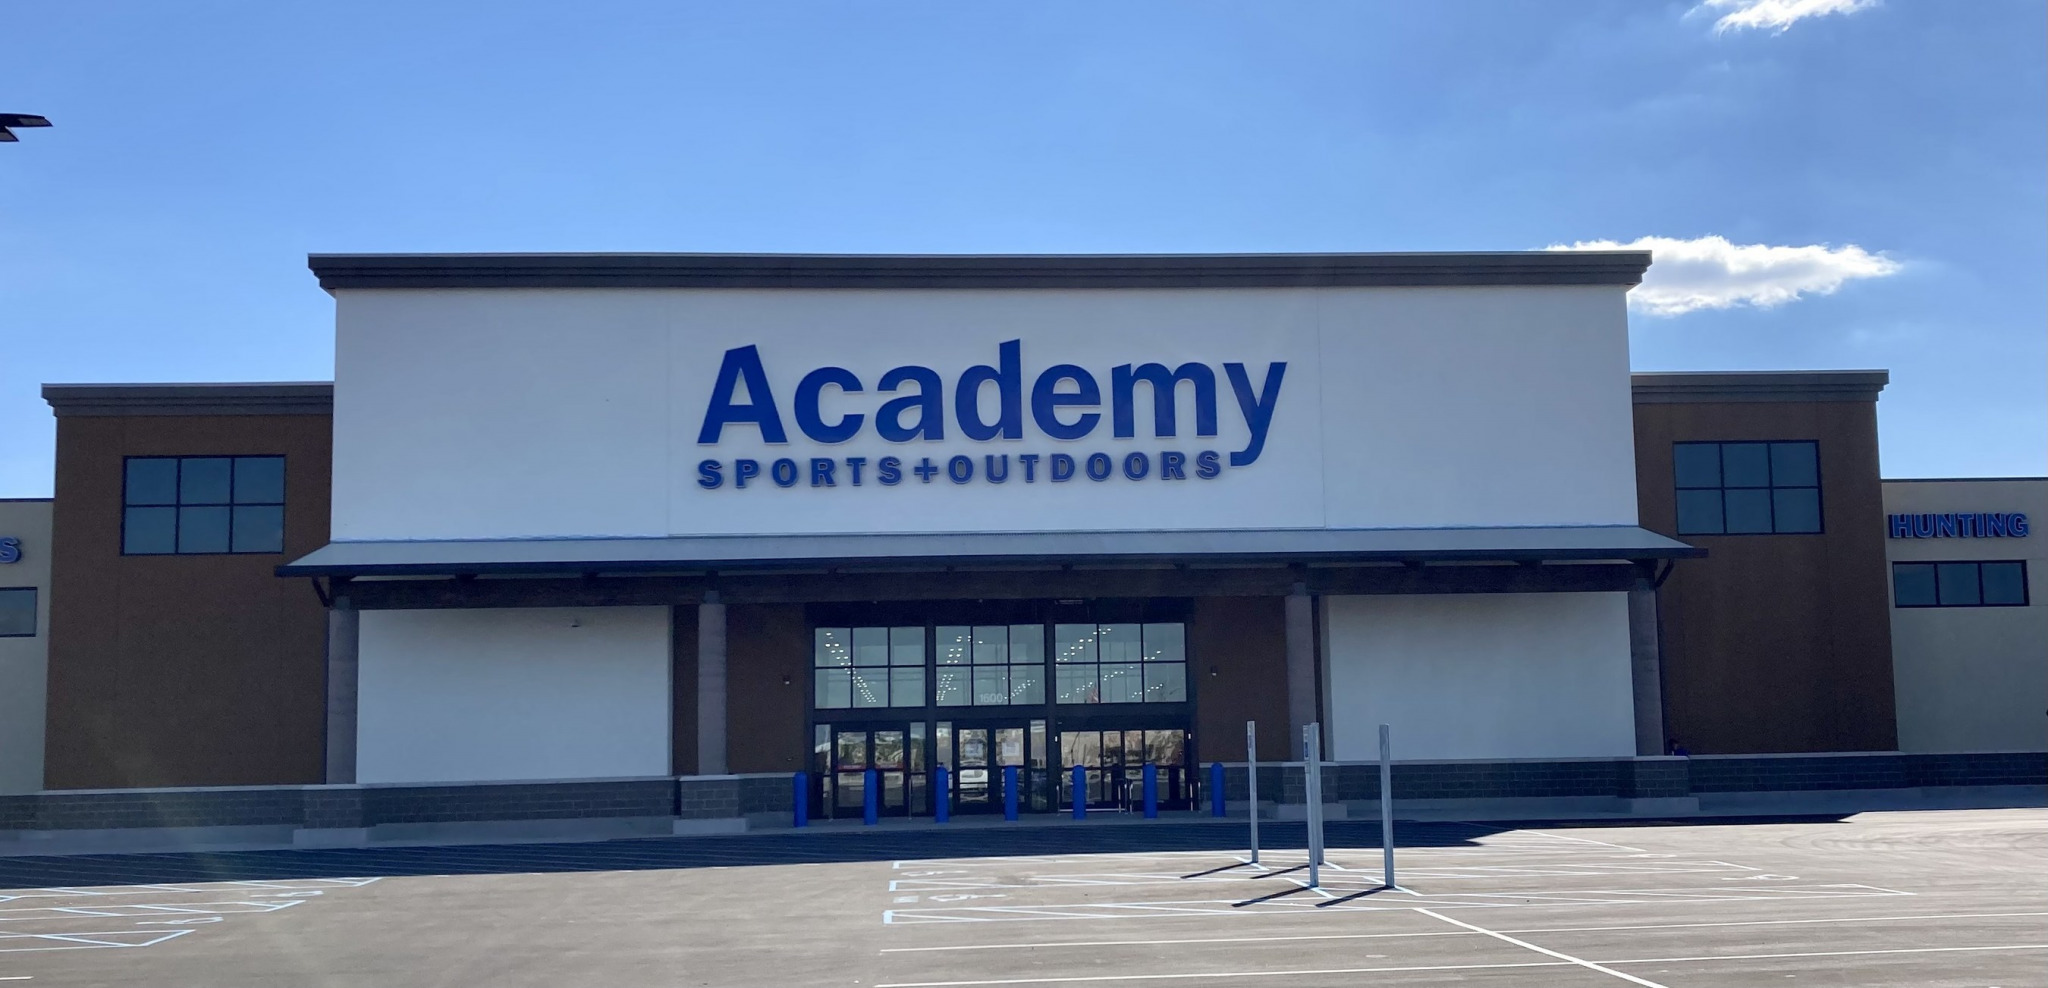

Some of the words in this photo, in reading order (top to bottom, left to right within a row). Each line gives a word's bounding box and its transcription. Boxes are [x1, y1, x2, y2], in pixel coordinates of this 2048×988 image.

[697, 339, 1287, 467] Academy
[697, 450, 1223, 489] SPORTS+OUTDOORS
[1889, 512, 2031, 538] HUNTING
[979, 693, 1003, 703] 1600
